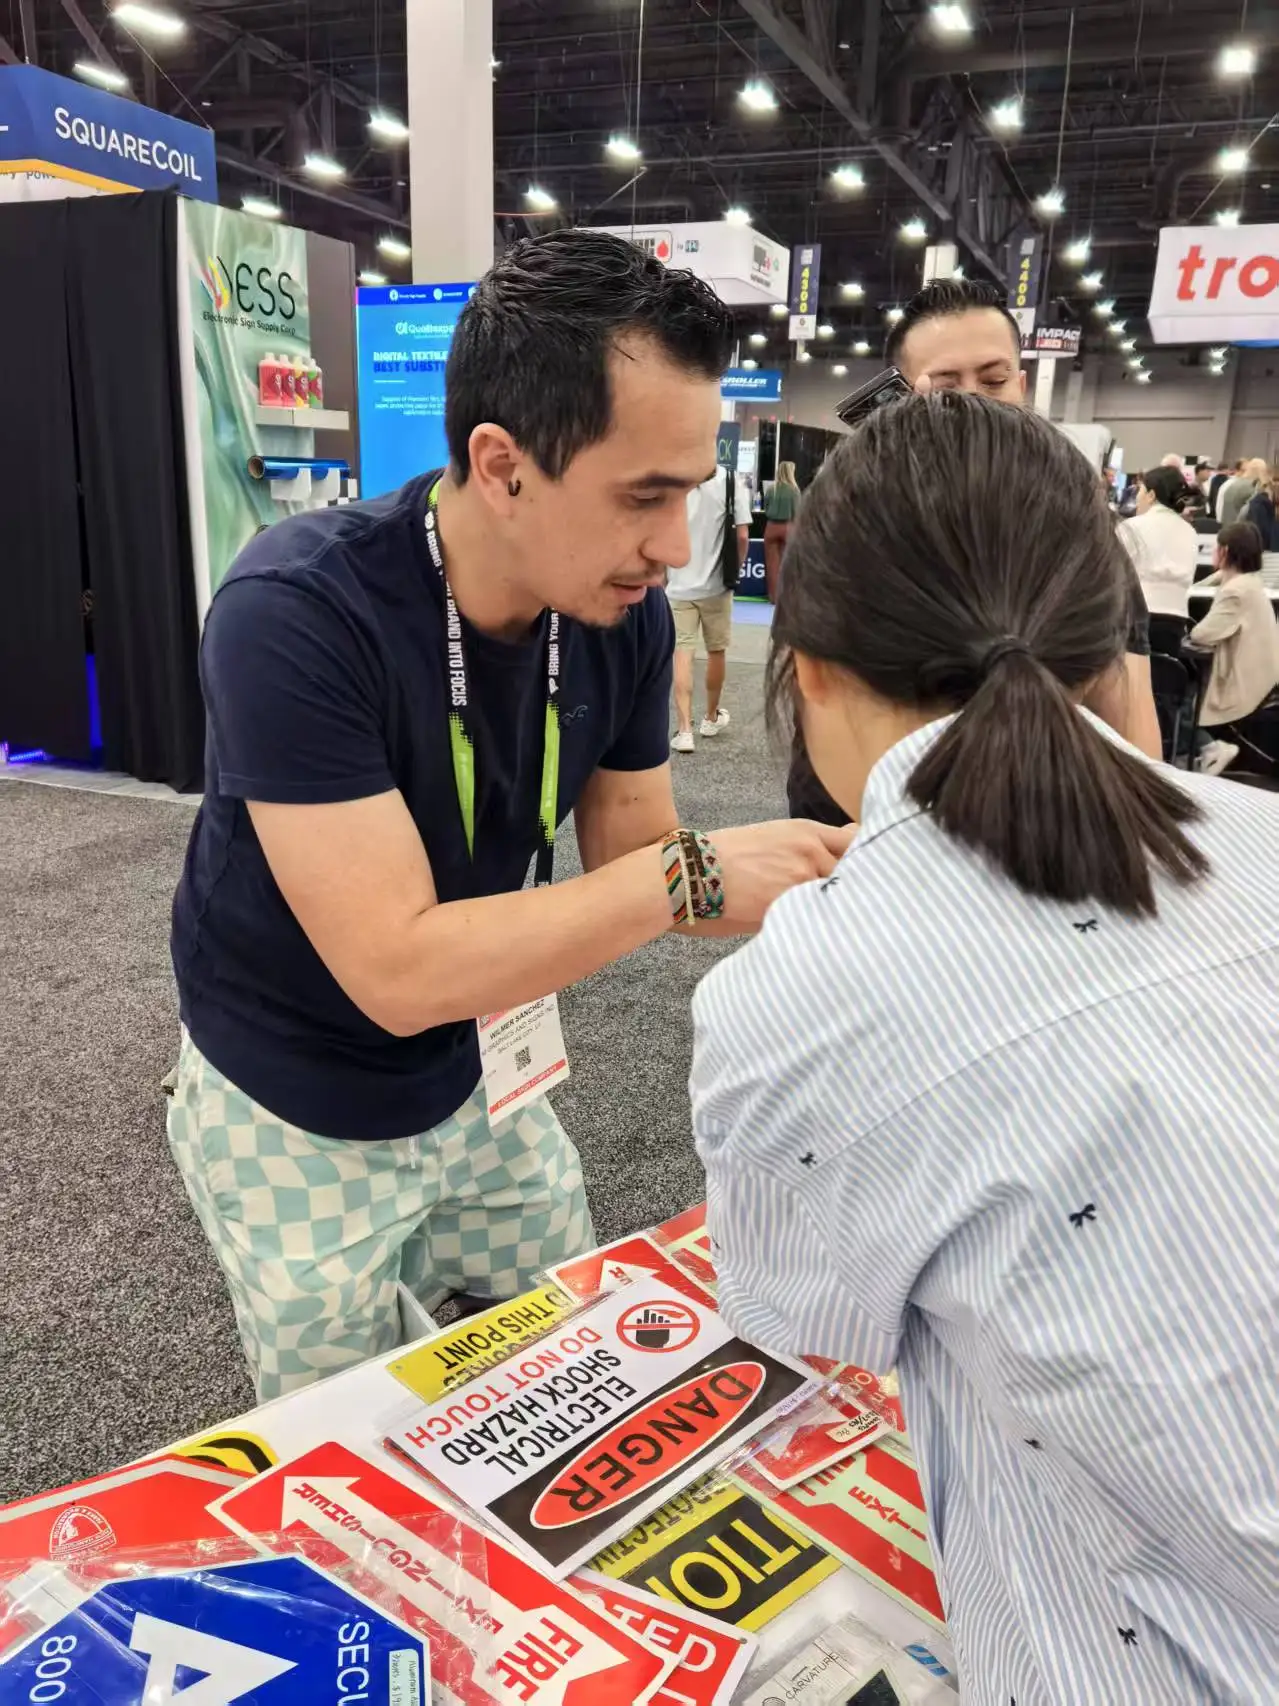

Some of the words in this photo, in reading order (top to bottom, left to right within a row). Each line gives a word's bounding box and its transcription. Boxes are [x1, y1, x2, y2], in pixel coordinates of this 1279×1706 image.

[235, 263, 296, 319] ESS
[1016, 257, 1030, 307] 4400
[1176, 245, 1279, 301] tro
[448, 642, 463, 668] INTO
[548, 644, 560, 675] BRING
[450, 671, 467, 706] FOCUS
[515, 999, 545, 1022] SANCHEZ
[433, 1323, 509, 1370] POINT
[499, 1303, 556, 1334] THIS
[560, 1326, 603, 1353] DO
[505, 1349, 565, 1391] NOT
[534, 1349, 622, 1406] SHOCK
[404, 1383, 510, 1449] TOUCH
[440, 1394, 548, 1466] HAZARD
[484, 1375, 637, 1475] ELECTRICAL
[551, 1369, 753, 1511] DANGER
[292, 1482, 504, 1634] EXTINGUISHER
[490, 1617, 585, 1702] FIRE
[588, 1596, 717, 1673] TED
[29, 1634, 77, 1703] 800
[785, 1650, 840, 1701] CARVATURE
